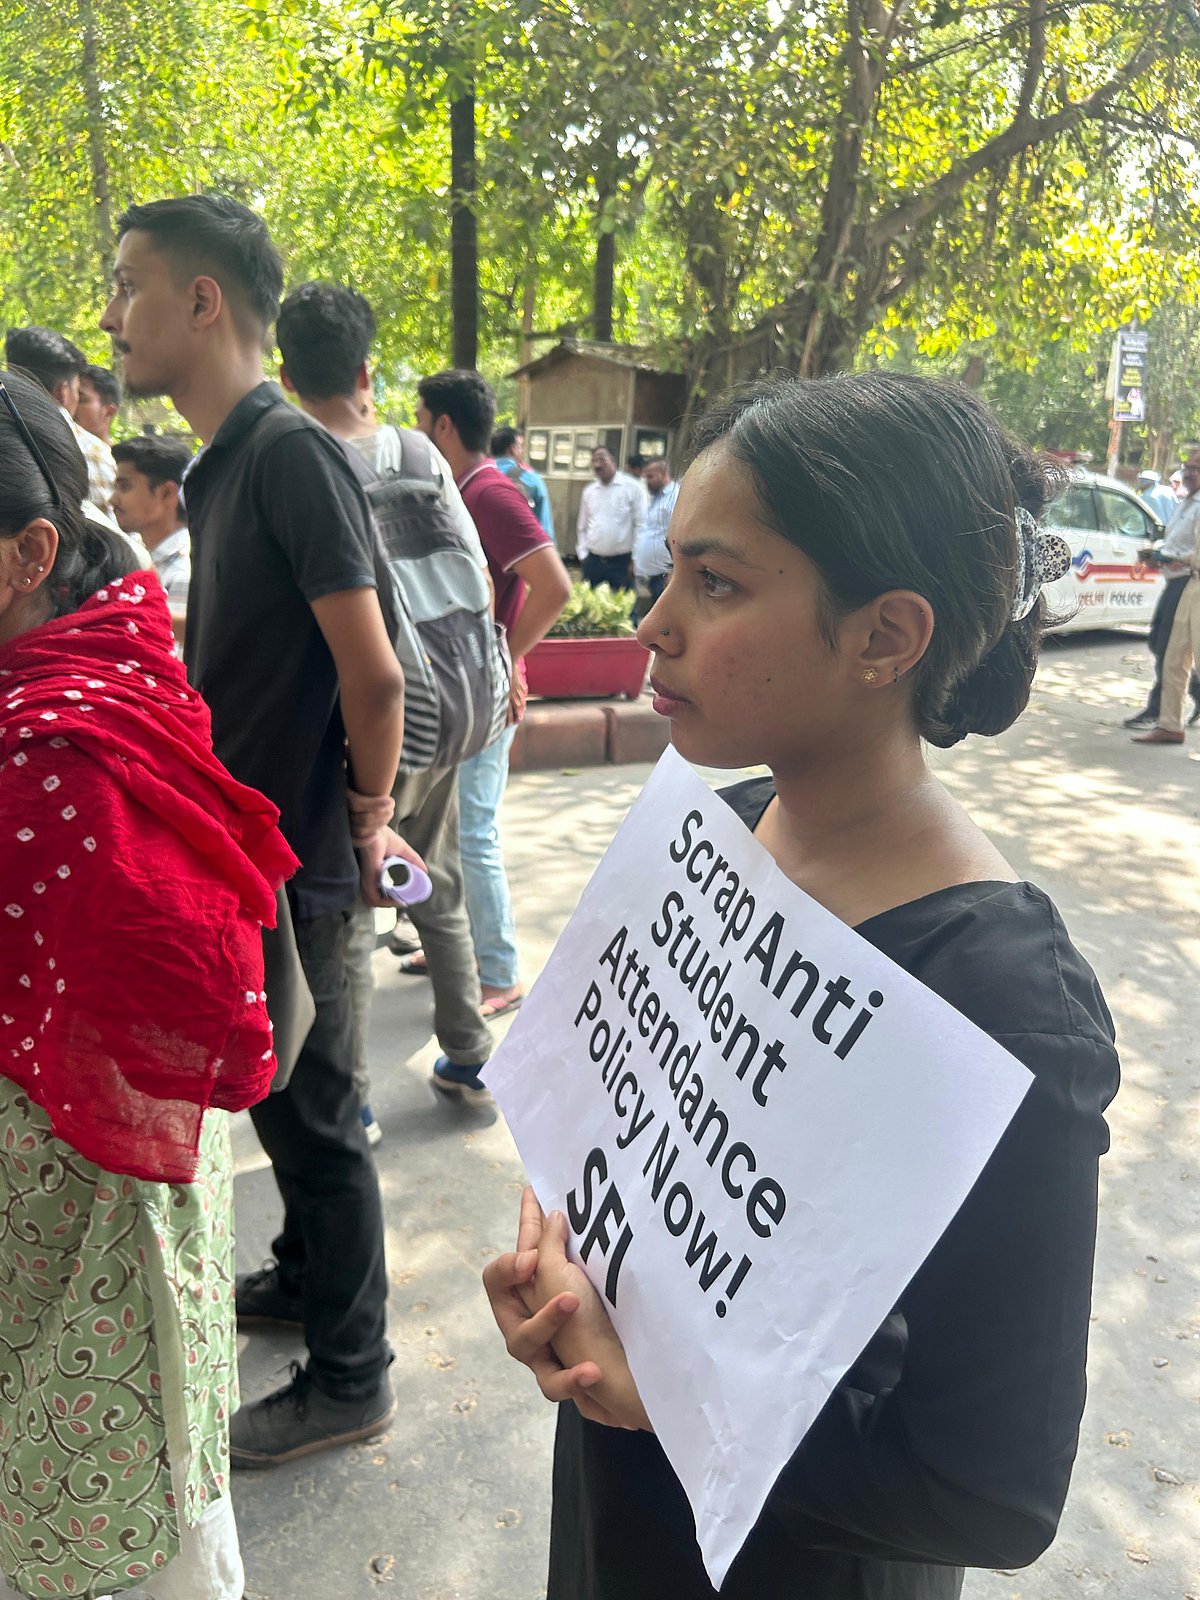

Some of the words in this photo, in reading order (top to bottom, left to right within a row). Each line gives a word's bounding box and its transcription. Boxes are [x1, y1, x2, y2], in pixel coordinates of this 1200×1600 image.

[1077, 591, 1104, 606] DELHI
[1110, 591, 1143, 606] POLICE
[650, 890, 788, 1108] Student
[669, 809, 756, 948] Scrap
[743, 910, 885, 1061] Anti
[574, 980, 655, 1150] Policy
[642, 1121, 753, 1319] Now!
[598, 925, 787, 1239] Attendance
[566, 1147, 634, 1308] SFI
